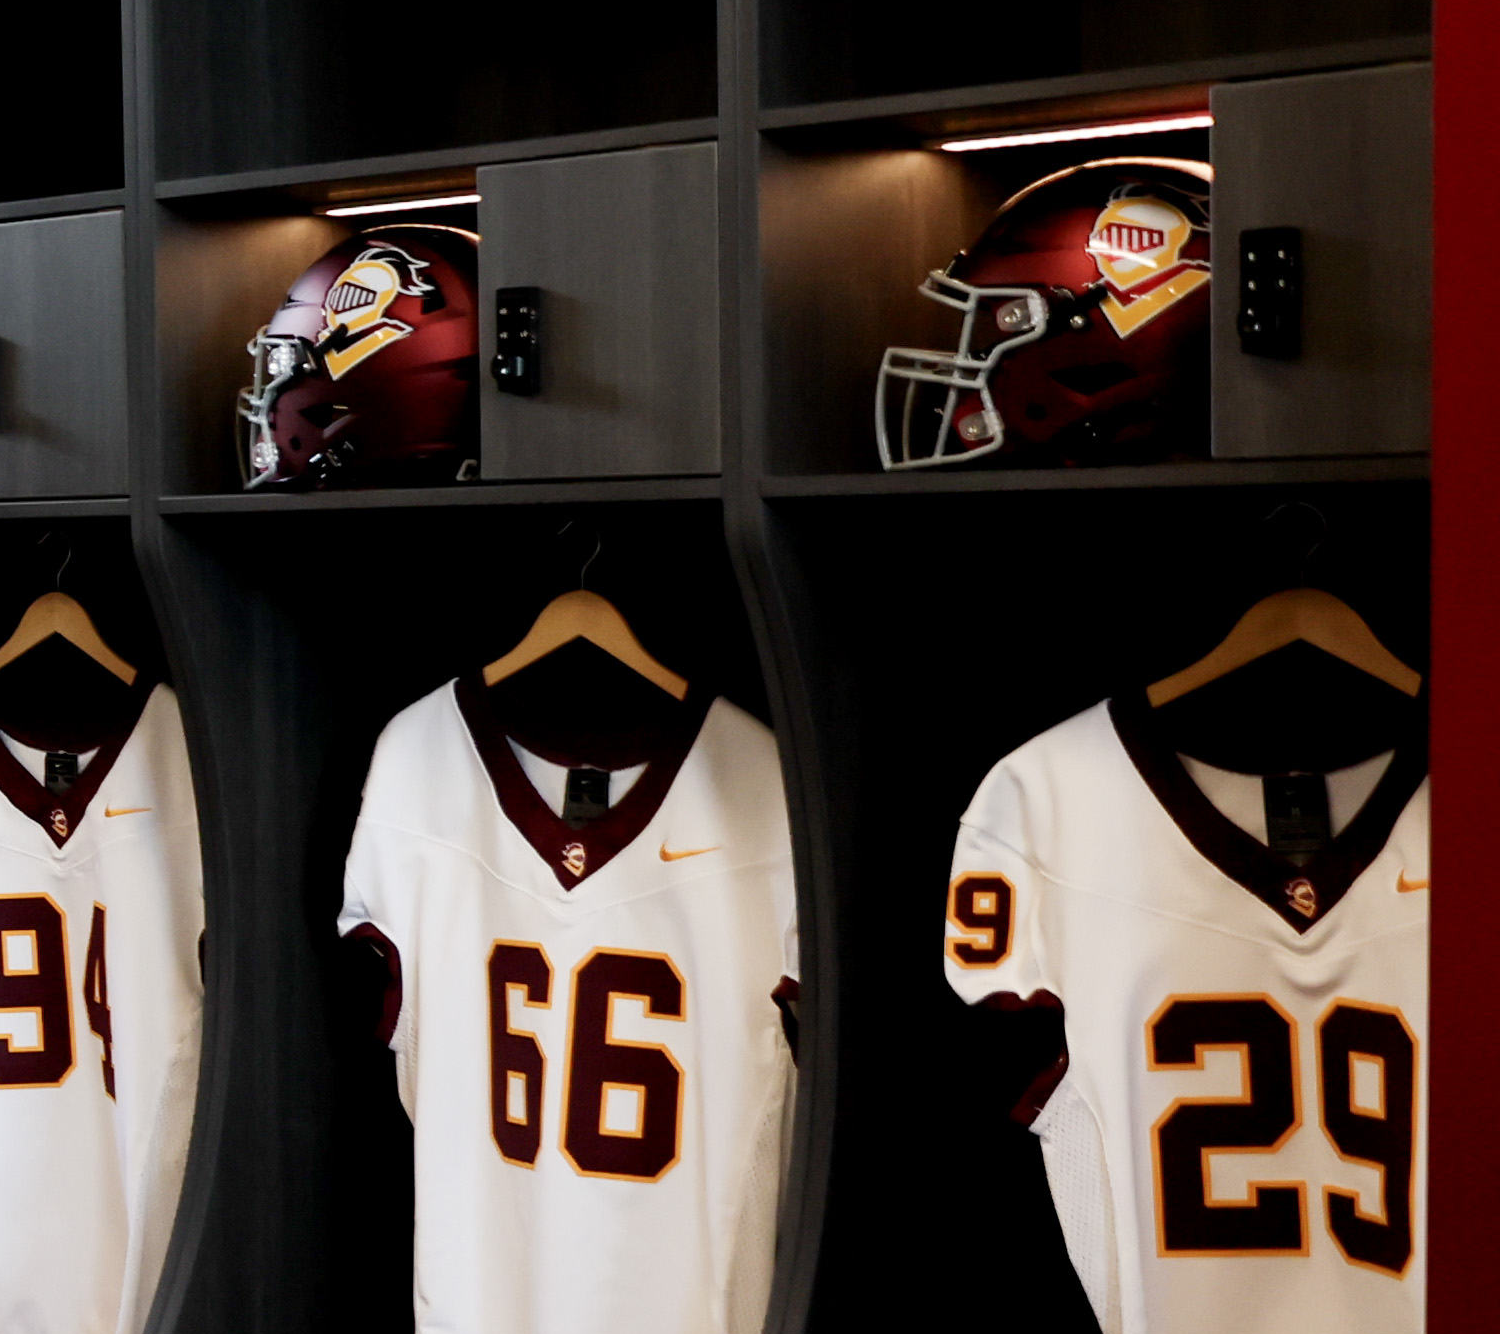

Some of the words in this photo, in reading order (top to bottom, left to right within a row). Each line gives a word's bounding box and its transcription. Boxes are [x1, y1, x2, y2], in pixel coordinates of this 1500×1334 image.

[945, 870, 1016, 970] 9
[486, 938, 687, 1183] 66
[1145, 992, 1419, 1281] 29
